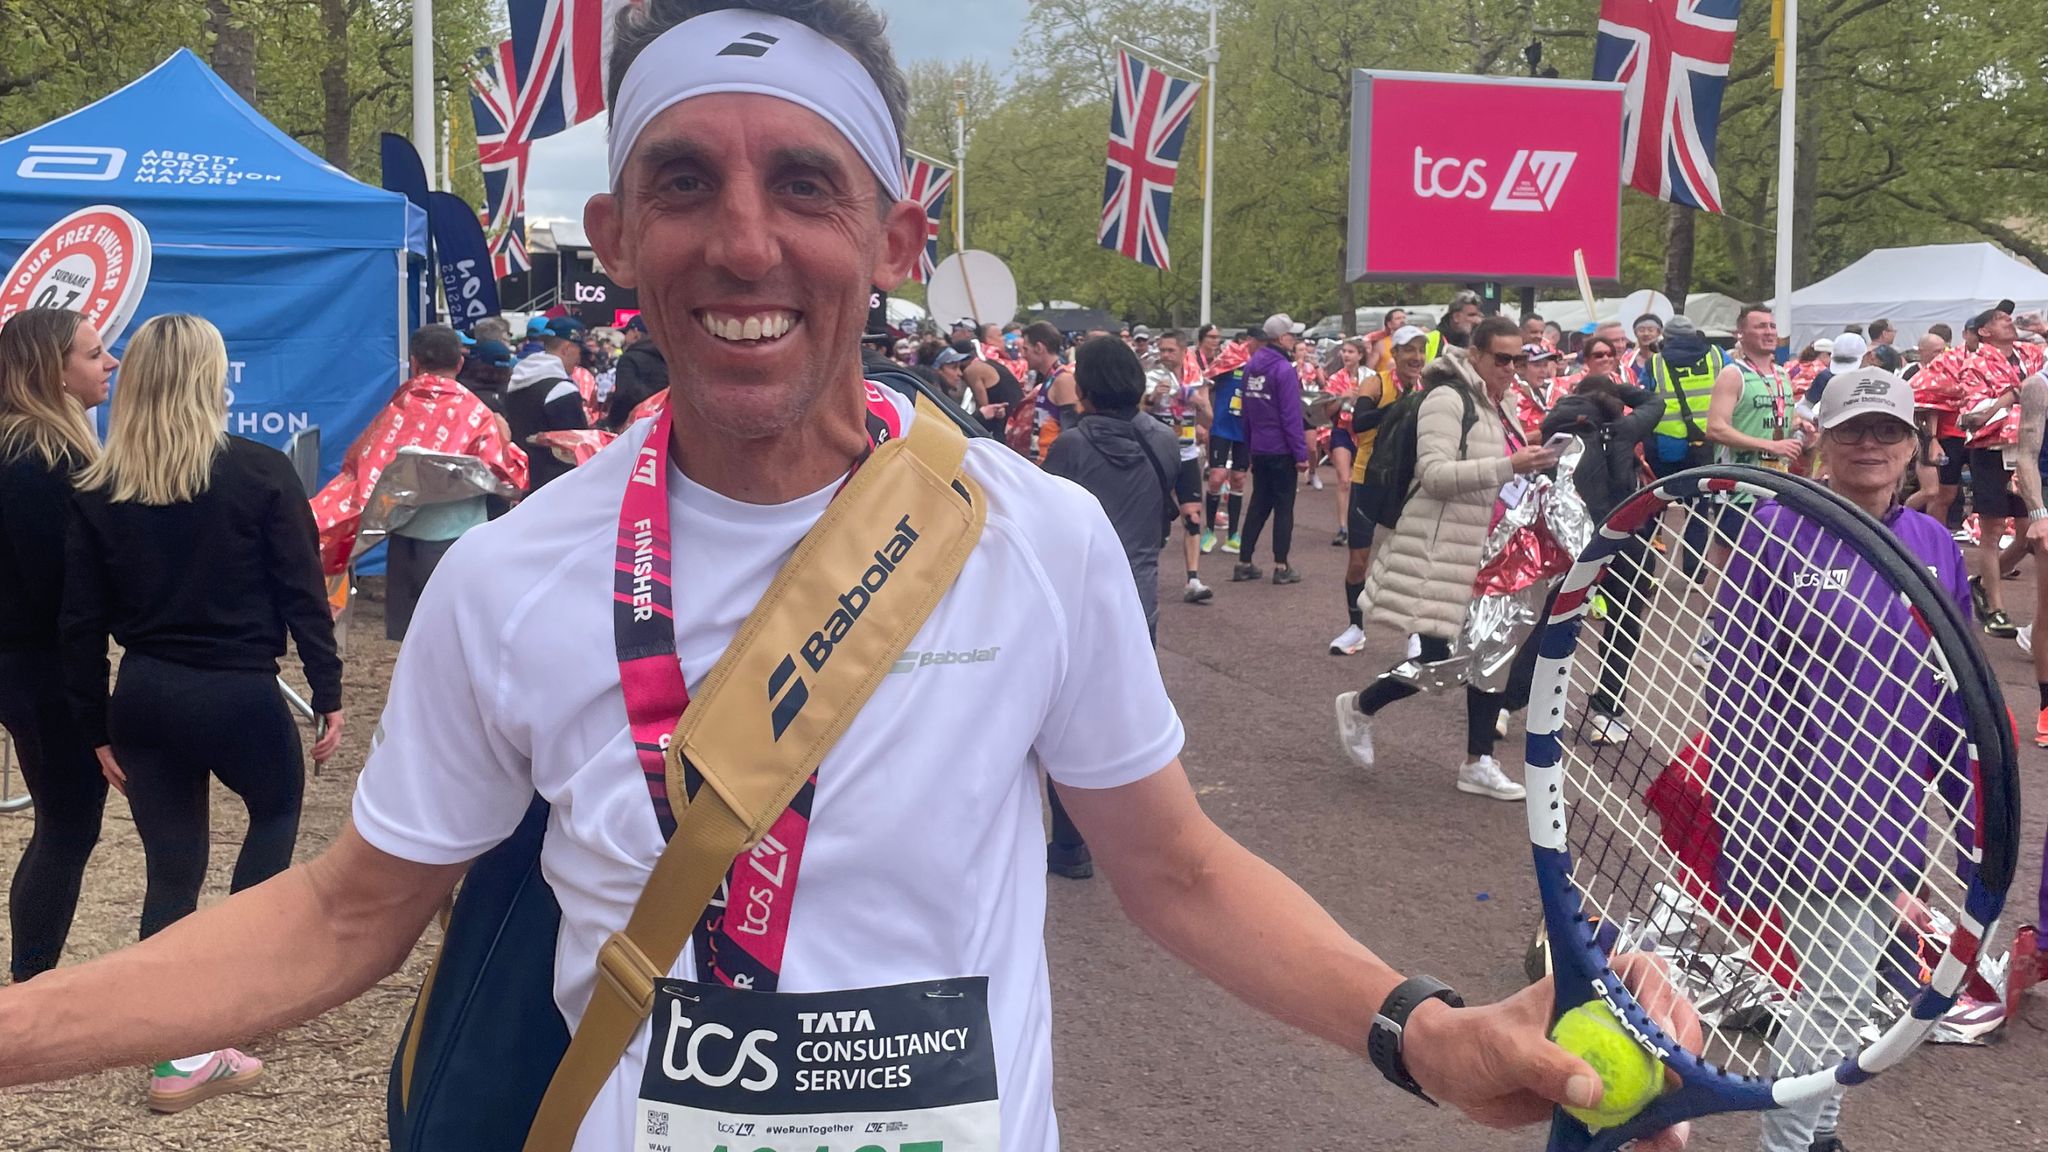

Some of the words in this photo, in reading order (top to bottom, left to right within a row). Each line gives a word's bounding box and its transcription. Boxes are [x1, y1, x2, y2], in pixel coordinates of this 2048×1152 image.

[141, 157, 228, 171] WORLD
[142, 149, 239, 165] ABBOTT
[134, 174, 238, 185] MAJORS
[137, 166, 281, 181] MARATHON
[1414, 146, 1487, 199] tcs
[0, 303, 18, 328] ET
[10, 247, 53, 297] YOUR
[56, 224, 95, 253] FREE
[92, 225, 124, 291] FINISHER
[51, 269, 91, 288] SURNAME
[574, 281, 606, 302] tcs
[633, 518, 653, 623] FINISHER
[1793, 571, 1821, 588] tcs
[737, 886, 773, 936] tcs
[798, 1010, 875, 1034] TATA
[662, 999, 779, 1092] tcs
[796, 1027, 969, 1064] CONSULTANCY
[795, 1064, 912, 1092] SERVICES
[718, 1121, 735, 1134] tcs
[766, 1124, 854, 1135] #WeRunTogether
